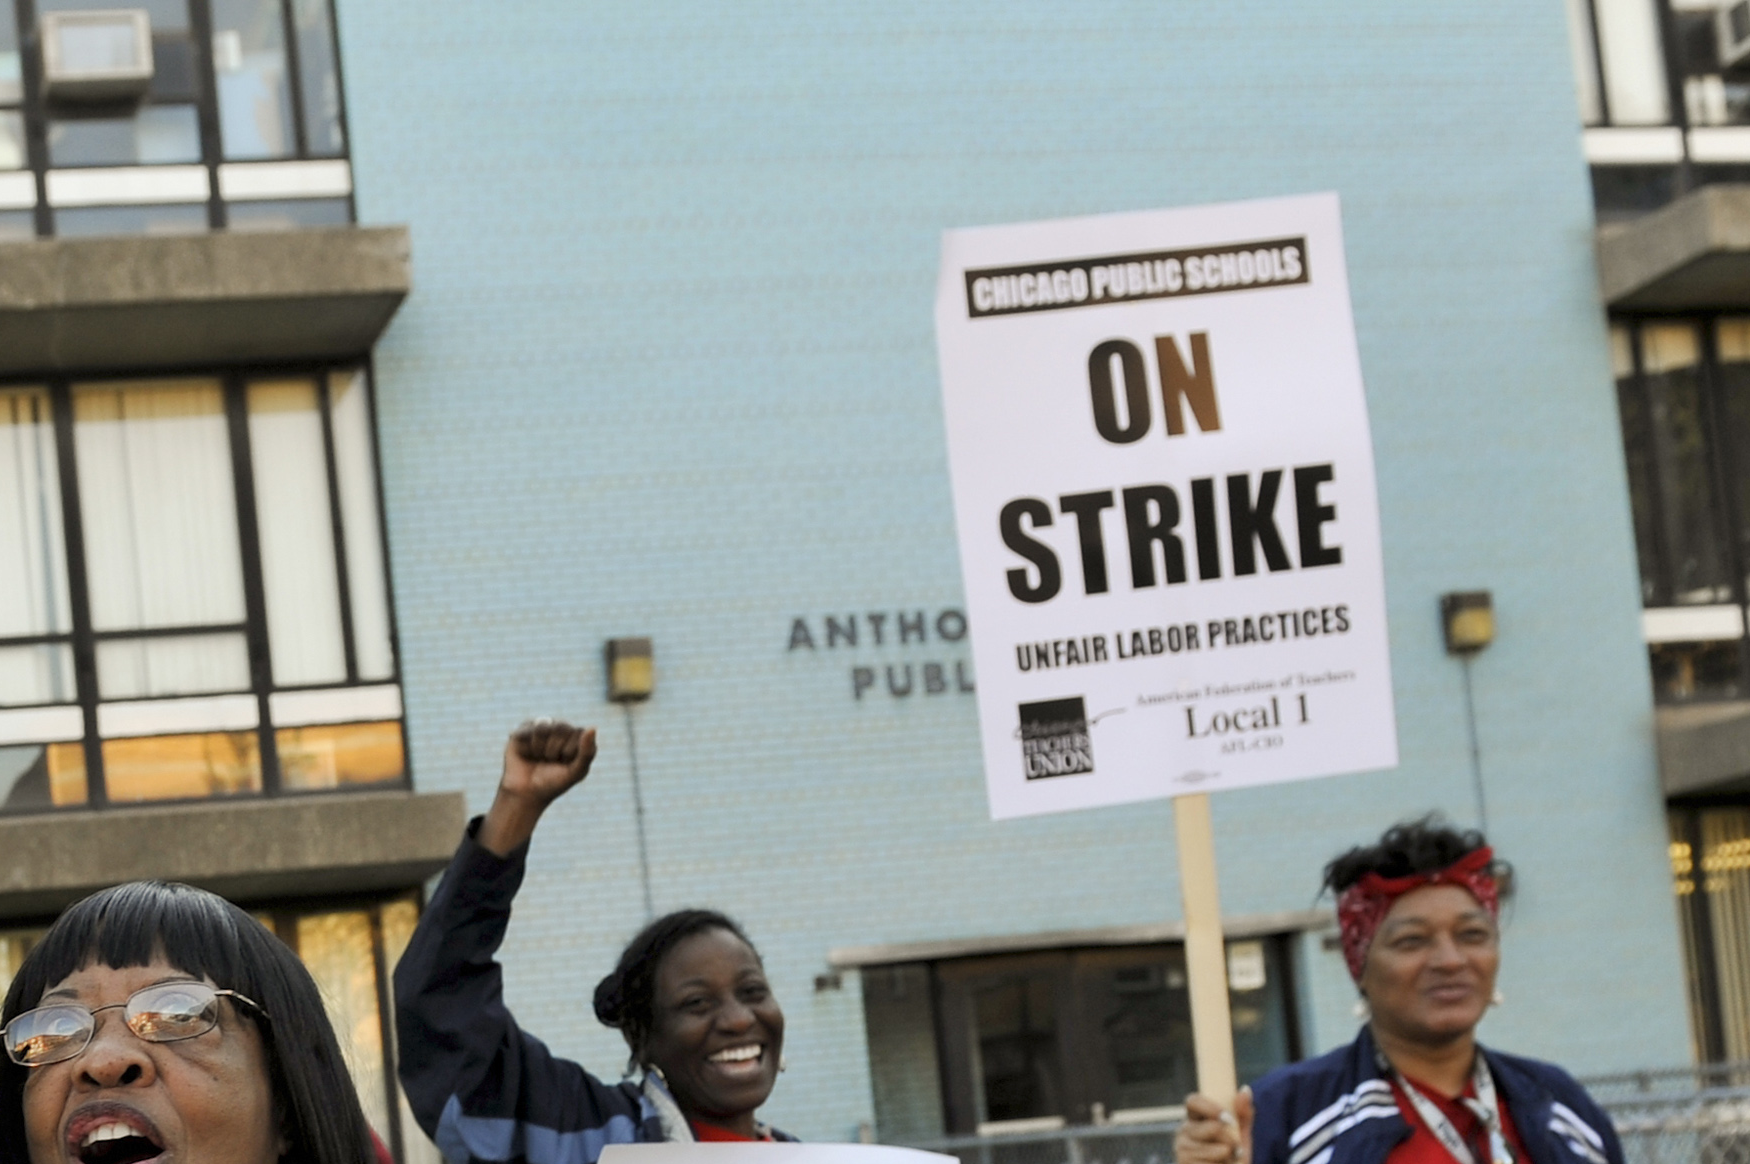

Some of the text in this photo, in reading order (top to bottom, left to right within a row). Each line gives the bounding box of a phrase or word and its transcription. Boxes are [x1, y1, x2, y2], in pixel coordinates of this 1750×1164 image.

[971, 245, 1301, 312] CHICAGO PUBLIC SCHOOLS
[1087, 330, 1222, 446] ON
[998, 462, 1344, 605] STRIKE
[1016, 604, 1351, 673] UNFAIR LABOR PRACTICES
[1184, 692, 1311, 739] Local 1
